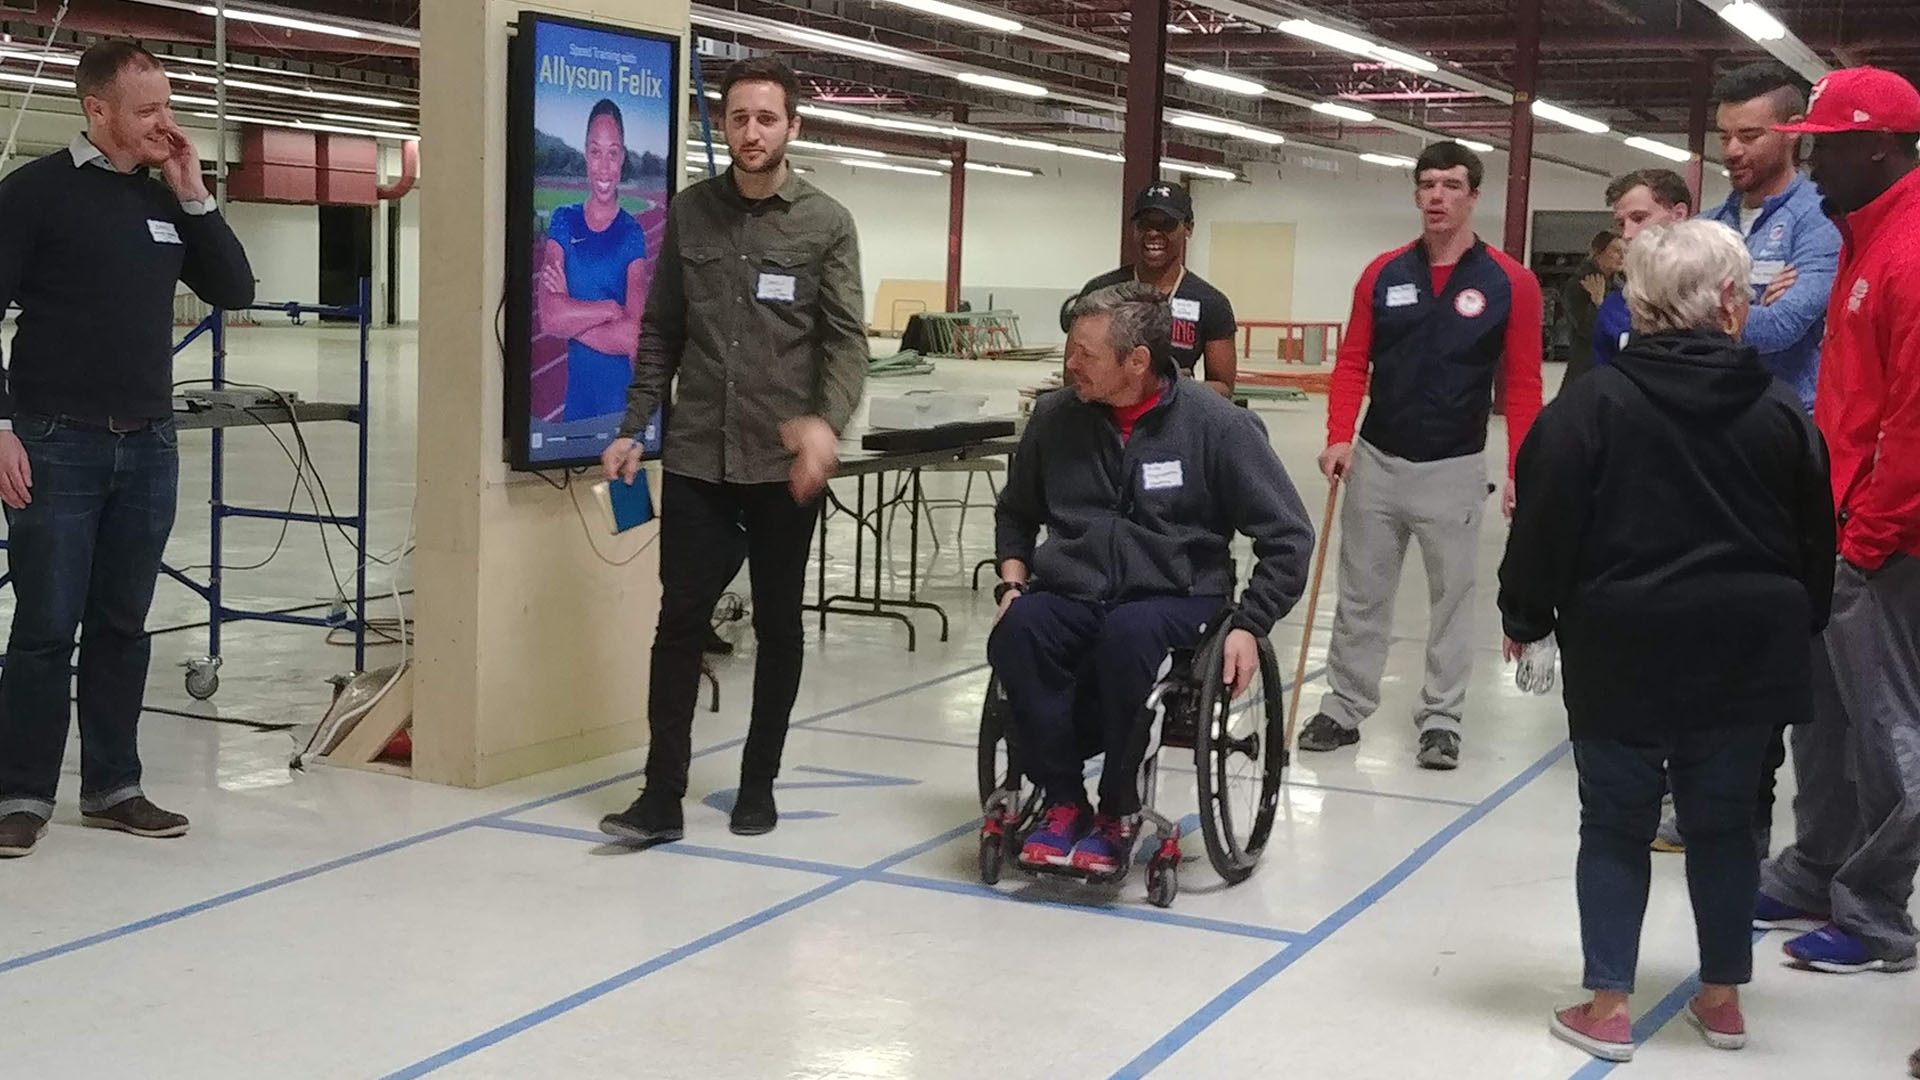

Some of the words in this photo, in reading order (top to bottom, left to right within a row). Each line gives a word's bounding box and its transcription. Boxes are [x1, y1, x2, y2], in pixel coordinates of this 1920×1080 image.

[569, 43, 593, 58] Speed
[592, 46, 621, 65] Training
[621, 52, 638, 65] with
[539, 54, 612, 94] Allyson
[618, 65, 663, 99] Felix
